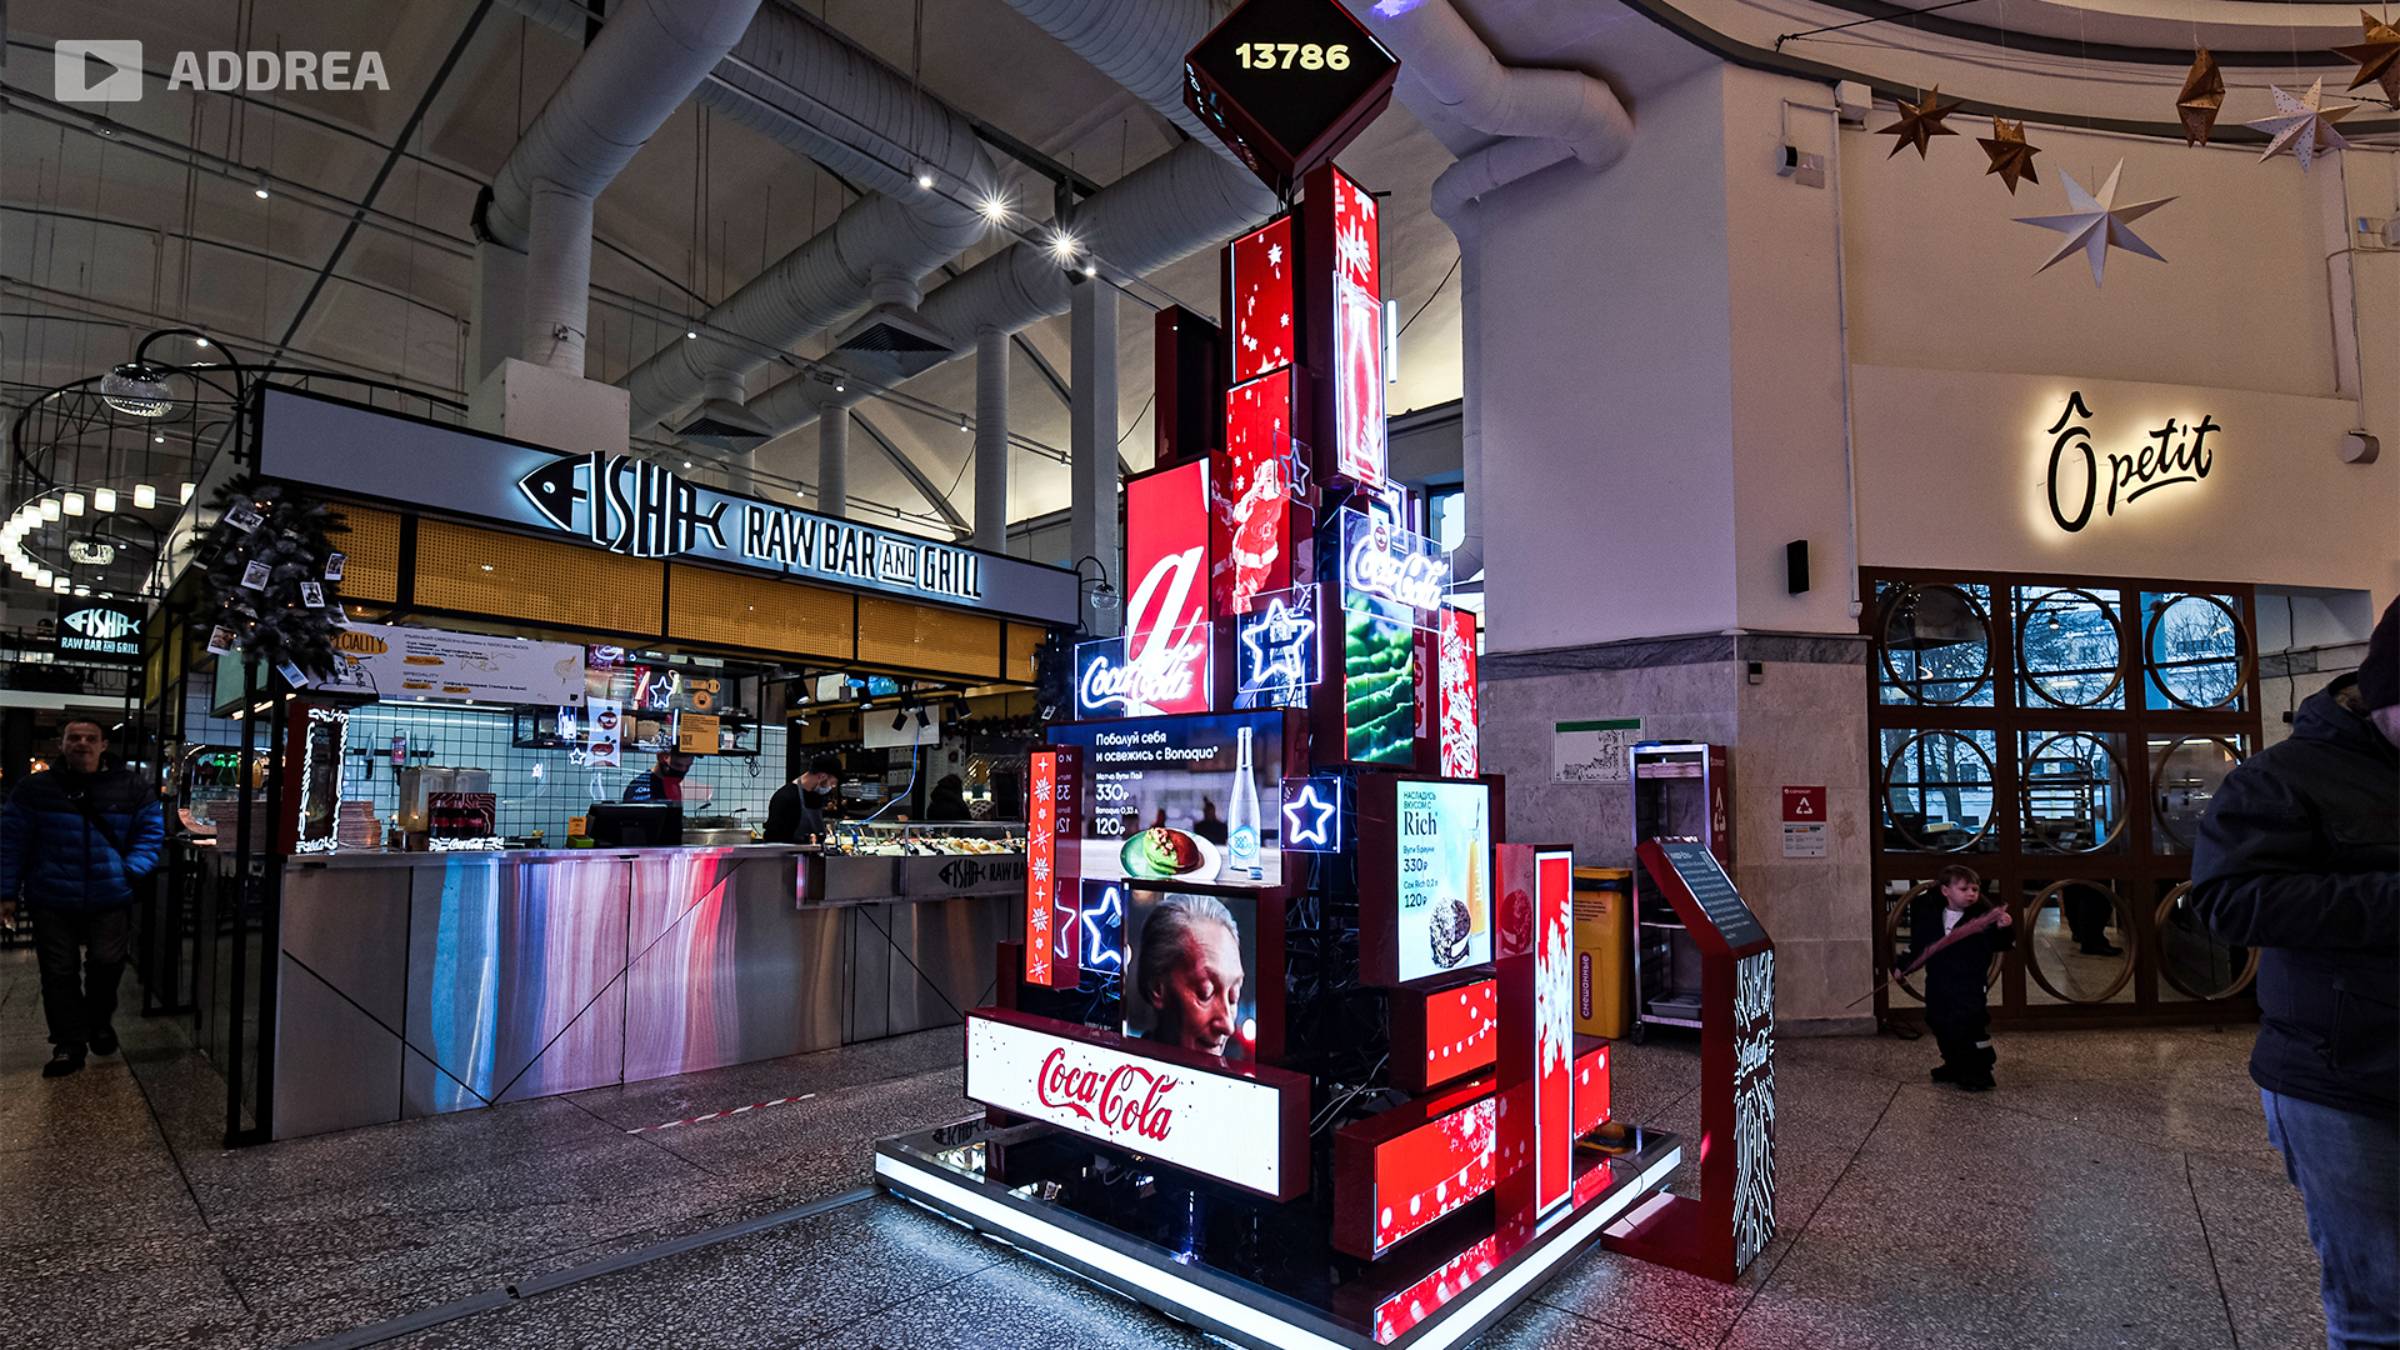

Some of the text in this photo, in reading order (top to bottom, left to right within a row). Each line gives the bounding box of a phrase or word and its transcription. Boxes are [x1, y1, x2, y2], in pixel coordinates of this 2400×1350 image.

[1236, 43, 1351, 71] 13786
[2047, 391, 2221, 533] Ô petit
[519, 451, 981, 600] FISHA RAW BAR AND GRILL
[64, 608, 141, 639] FISHA
[61, 637, 83, 649] RAW
[84, 639, 101, 651] BAR
[117, 642, 139, 654] GRILL
[1096, 731, 1167, 747] Побалуй себя
[1096, 753, 1103, 762] и
[1104, 750, 1154, 762] освежись
[1156, 751, 1162, 760] с
[990, 863, 1012, 881] RAW
[1014, 863, 1025, 881] BA
[1582, 954, 1590, 1018] смешанные
[1038, 1047, 1179, 1141] Coca-Cola
